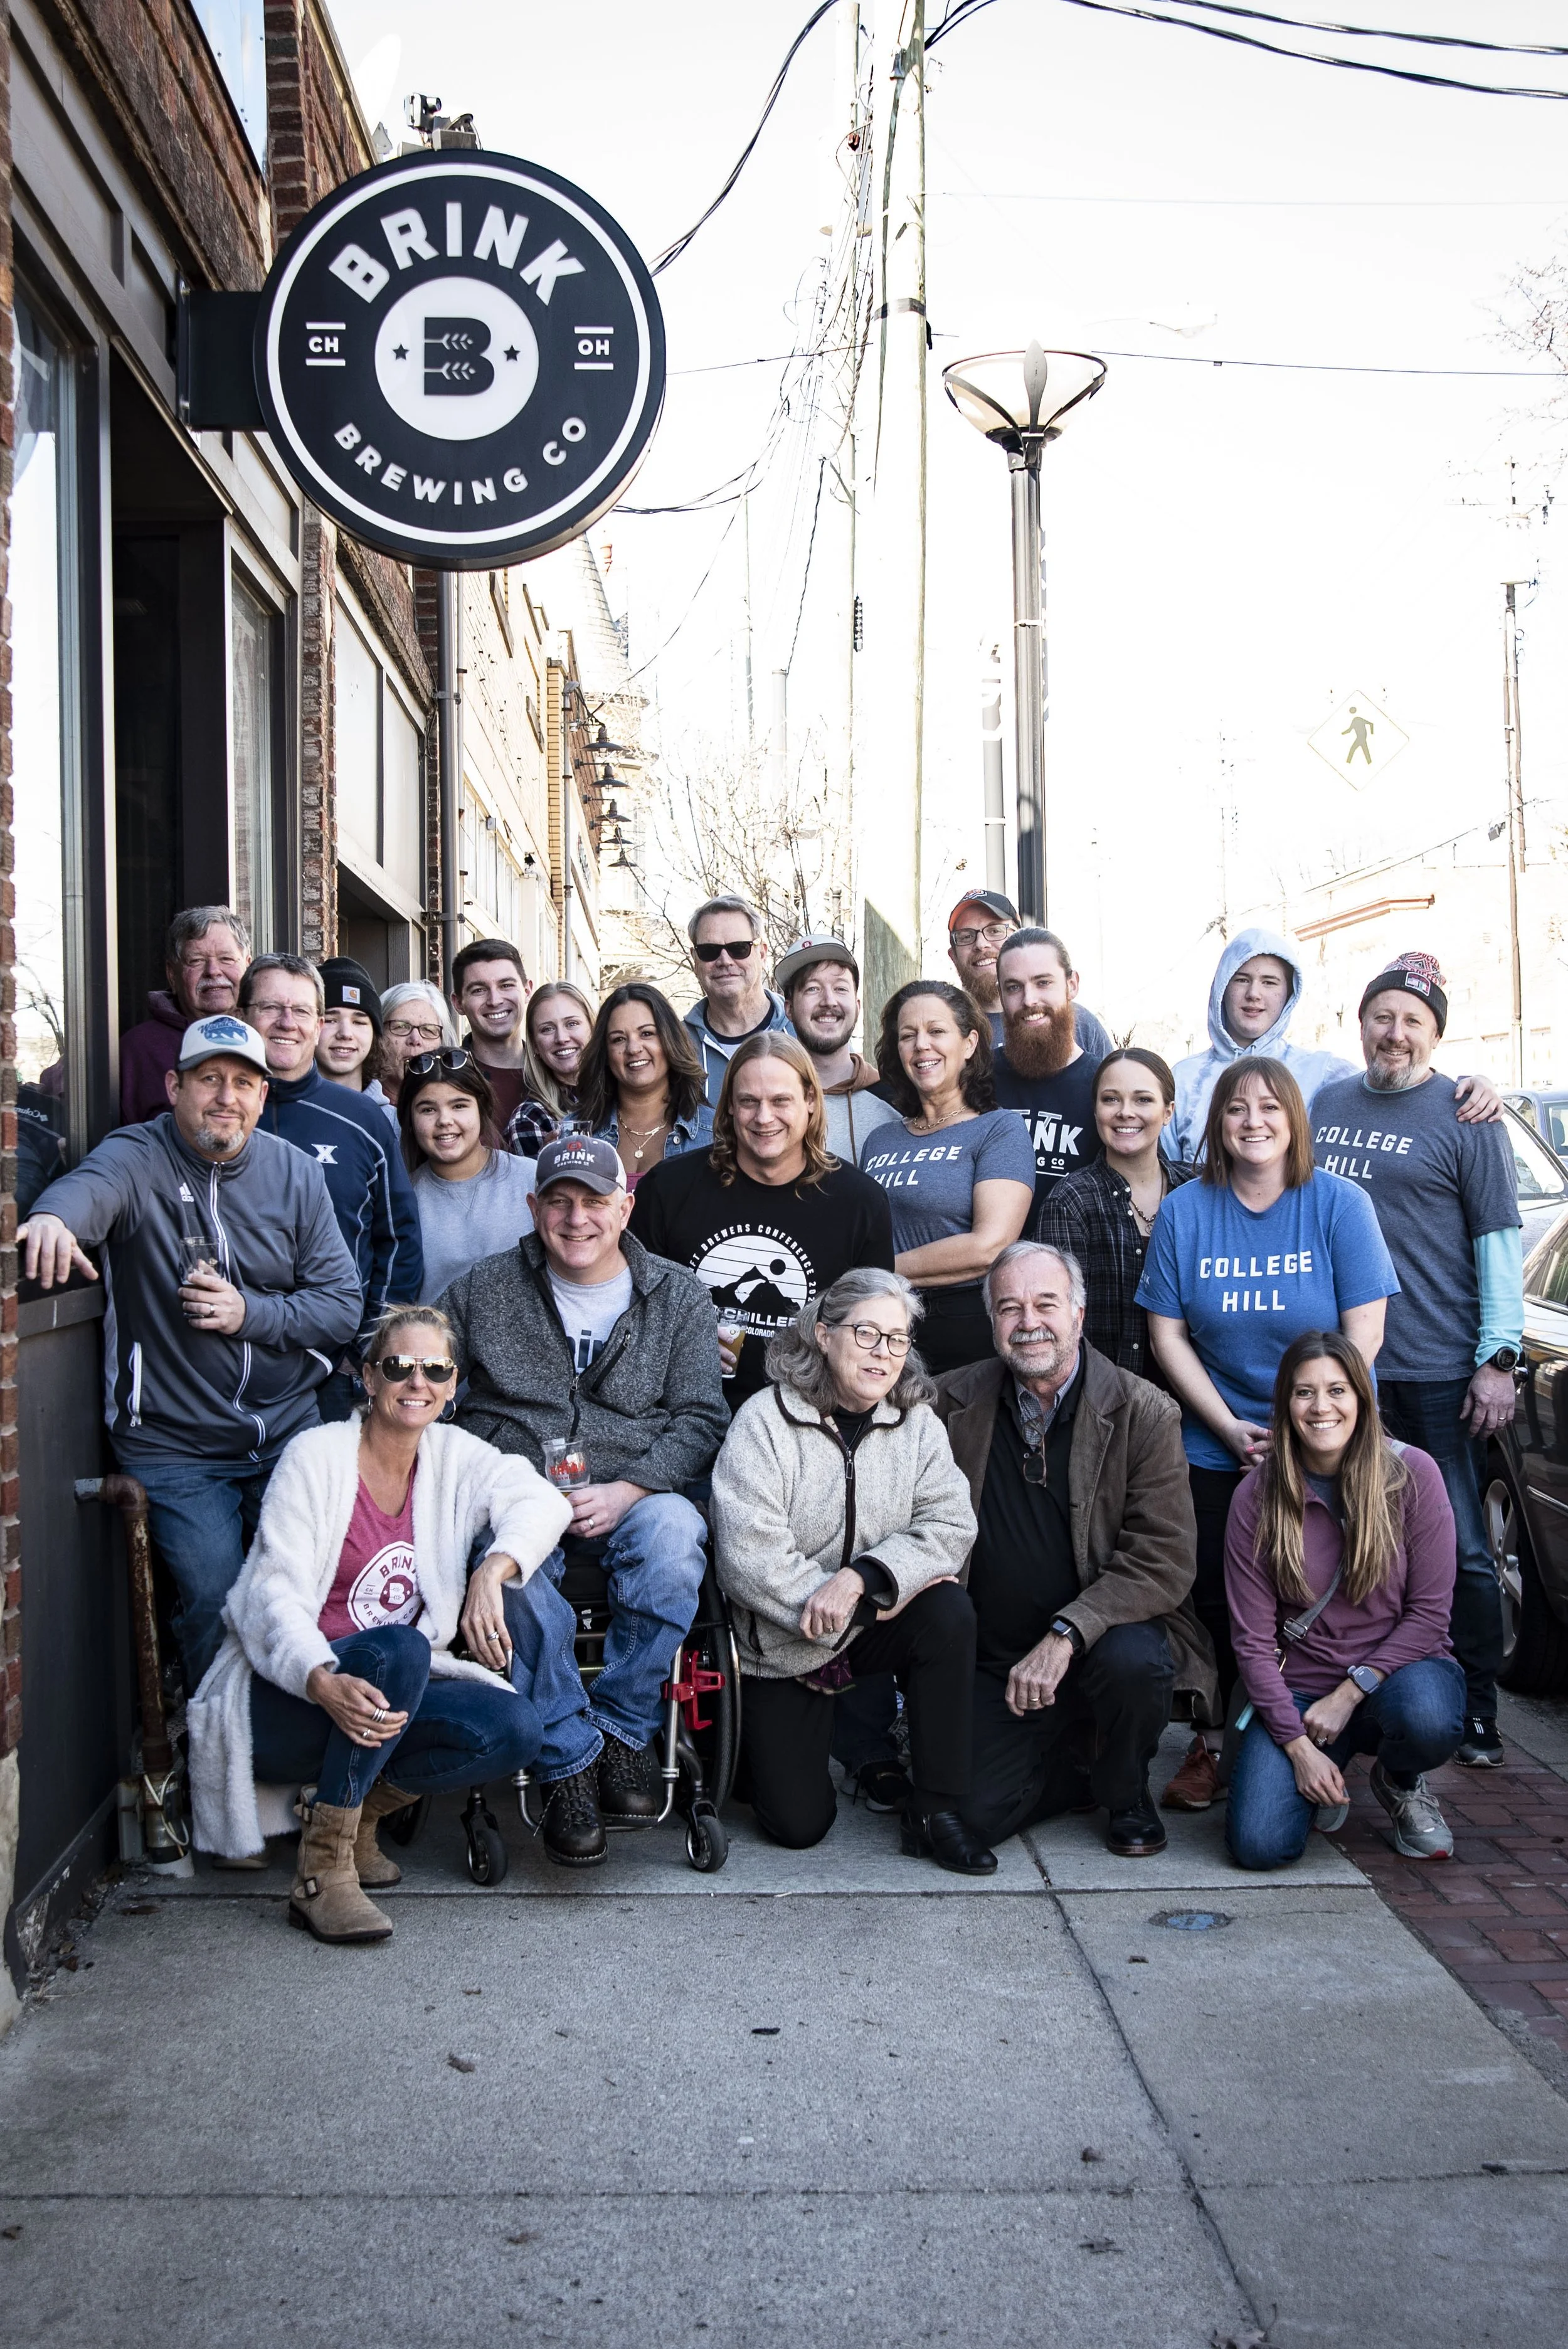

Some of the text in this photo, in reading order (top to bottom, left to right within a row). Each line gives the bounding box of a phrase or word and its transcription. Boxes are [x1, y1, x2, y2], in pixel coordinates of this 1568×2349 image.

[328, 201, 586, 305] BRINK
[308, 336, 339, 353] CH
[578, 339, 610, 356] OH
[424, 317, 494, 396] B
[334, 416, 586, 504] BREWING CO
[1315, 1126, 1414, 1155] COLLEGE
[311, 1143, 338, 1164] X
[554, 1150, 595, 1164] BRINK
[866, 1145, 963, 1172] COLLEGE
[1051, 1157, 1064, 1166] CO
[1325, 1155, 1372, 1179] HILL
[701, 1224, 750, 1251] BREWERS
[758, 1224, 815, 1275] CONFERENCE
[1200, 1251, 1313, 1278] COLLEGE
[1222, 1290, 1285, 1312] HILL
[379, 1556, 416, 1578] BRIN
[403, 1608, 413, 1619] CO
